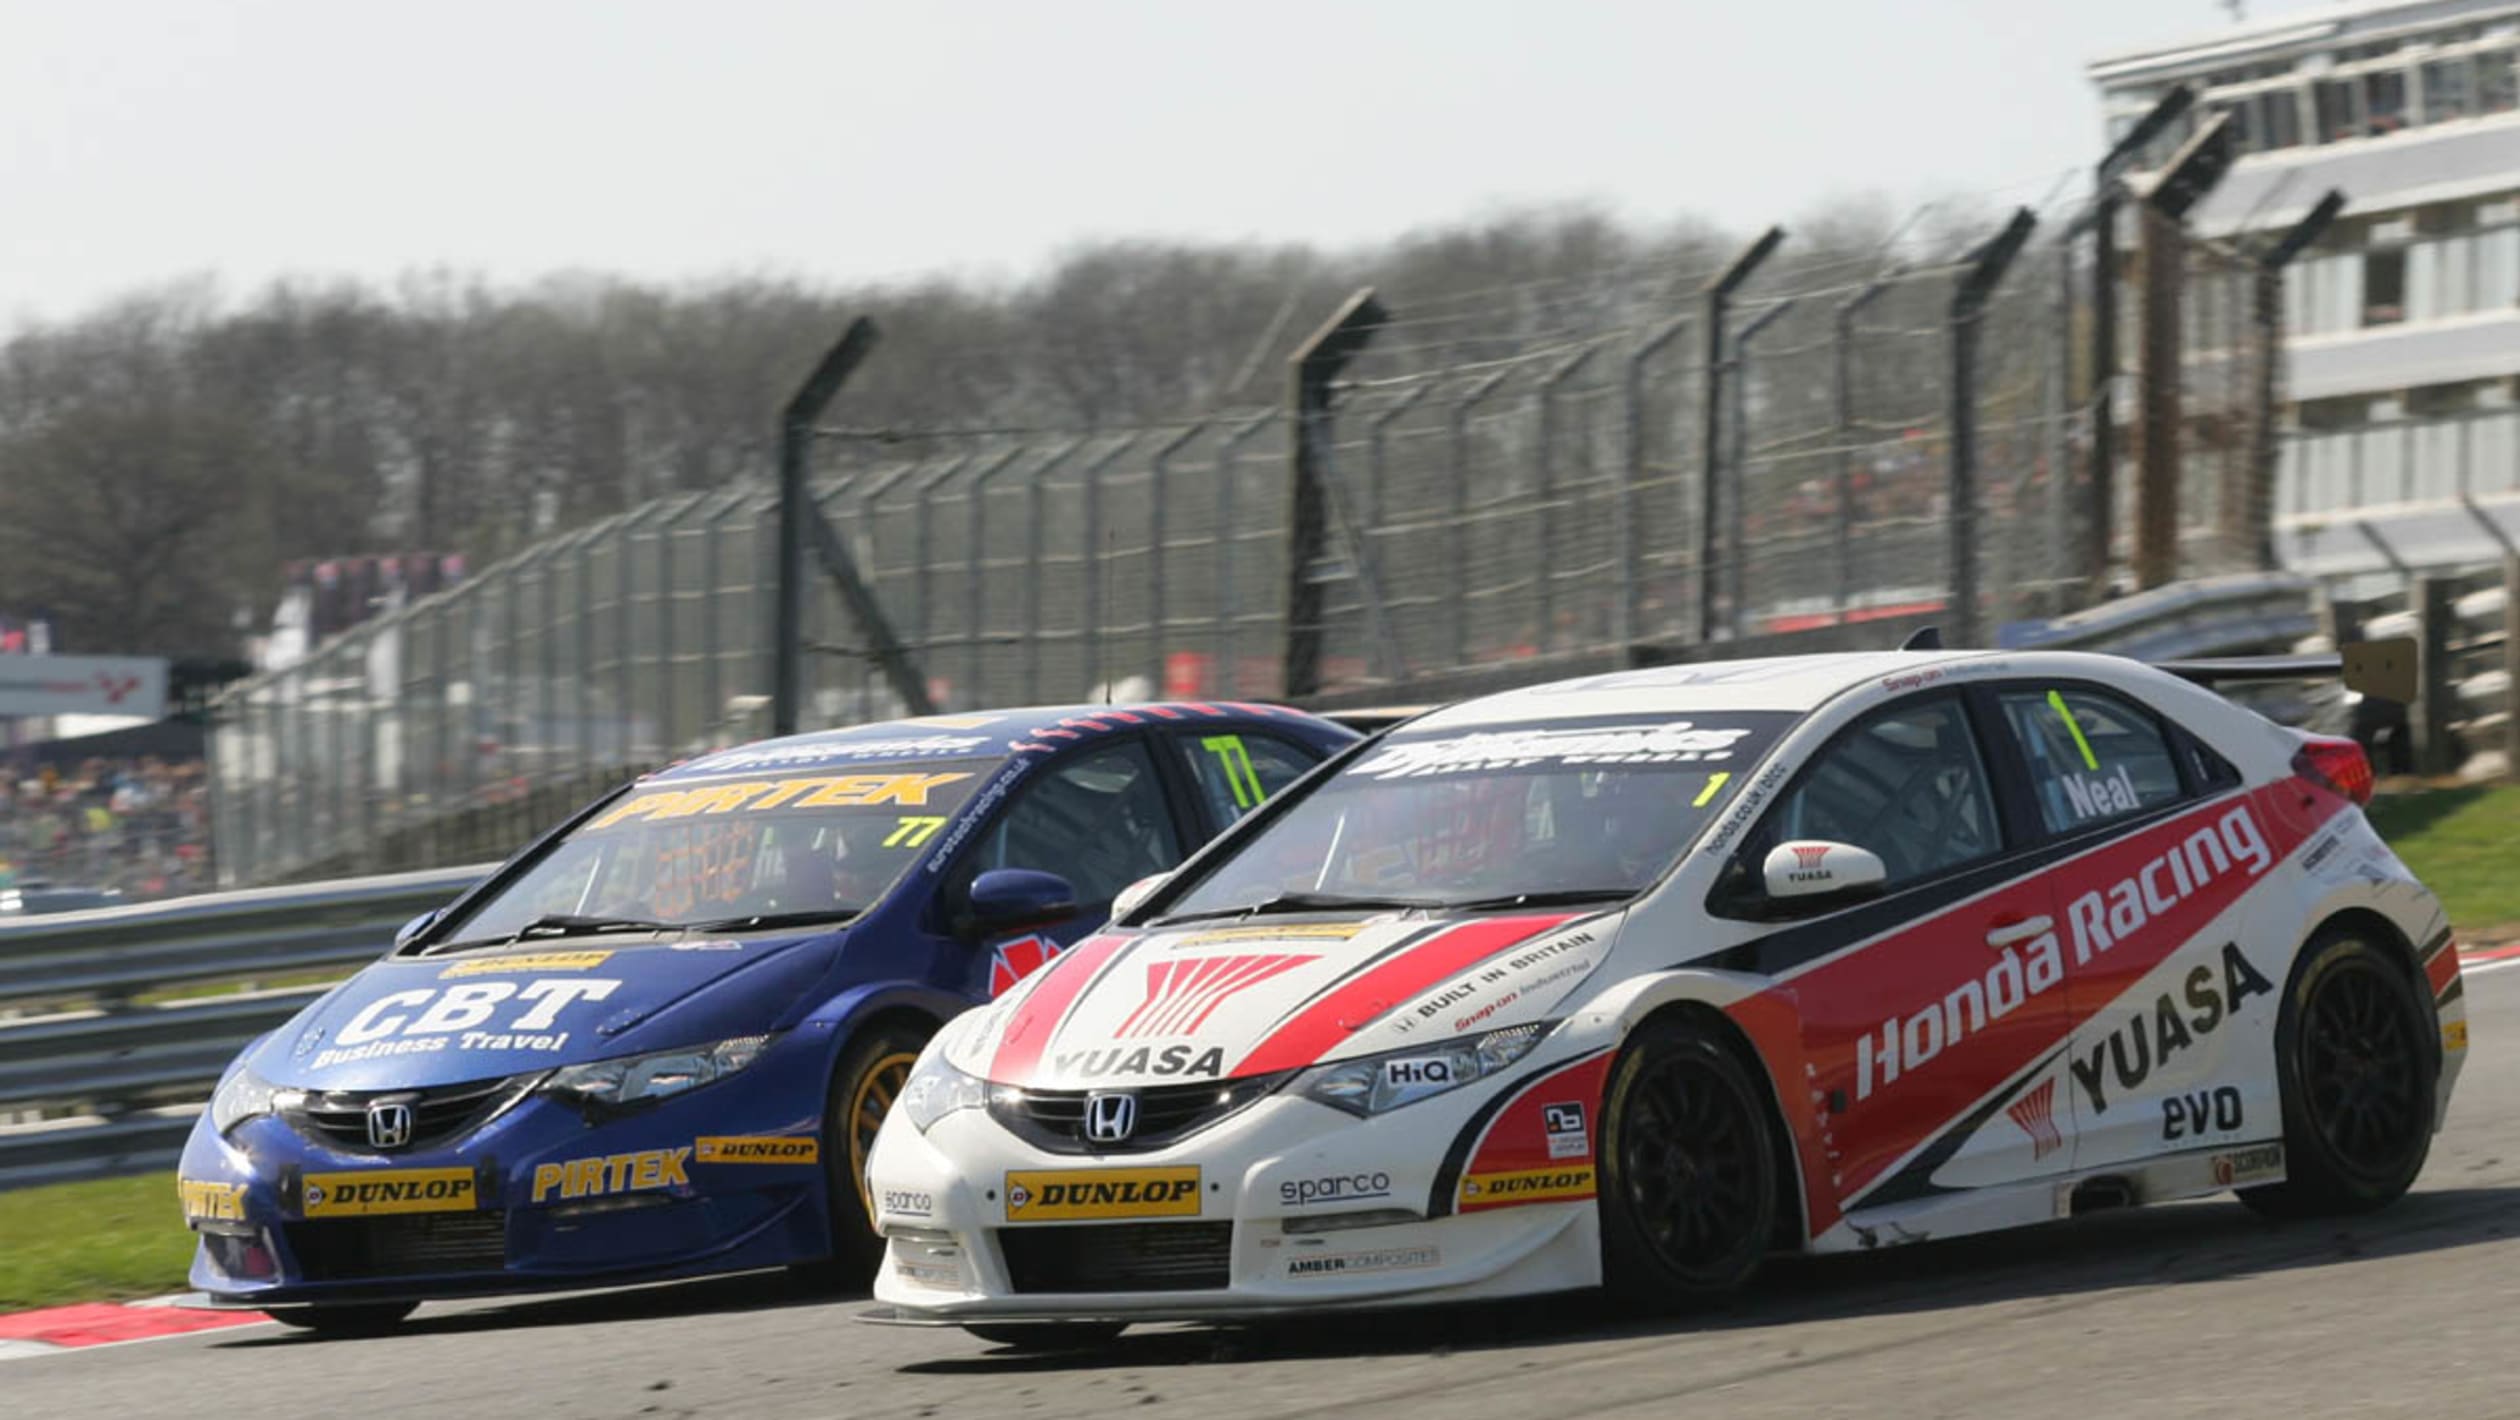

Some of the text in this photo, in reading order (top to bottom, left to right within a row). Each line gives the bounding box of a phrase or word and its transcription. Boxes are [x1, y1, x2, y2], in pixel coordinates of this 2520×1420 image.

[2048, 690, 2098, 770] 1
[1202, 734, 1267, 809] 77
[1692, 772, 1731, 807] 1
[586, 772, 976, 830] PIRTEK
[2062, 765, 2142, 820] Neal
[882, 816, 947, 848] 77
[1788, 870, 1832, 883] YUASA
[1856, 806, 2271, 1100] Honda Racing
[1417, 932, 1595, 1019] BUILT IN BRITAIN
[335, 979, 624, 1045] CBT
[2070, 941, 2273, 1114] YUASA
[309, 1031, 569, 1070] Business Travel
[1052, 1045, 1225, 1078] YUASA
[1390, 1059, 1452, 1086] HiQ
[2162, 1086, 2243, 1140] evo
[719, 1143, 814, 1156] DUNLOP
[332, 1179, 473, 1204] DUNLOP
[531, 1146, 693, 1202] PIRTEK
[1281, 1172, 1391, 1204] sparco
[1488, 1171, 1592, 1194] DUNLOP
[1037, 1180, 1197, 1206] DUNLOP
[1288, 1258, 1345, 1274] AMBER
